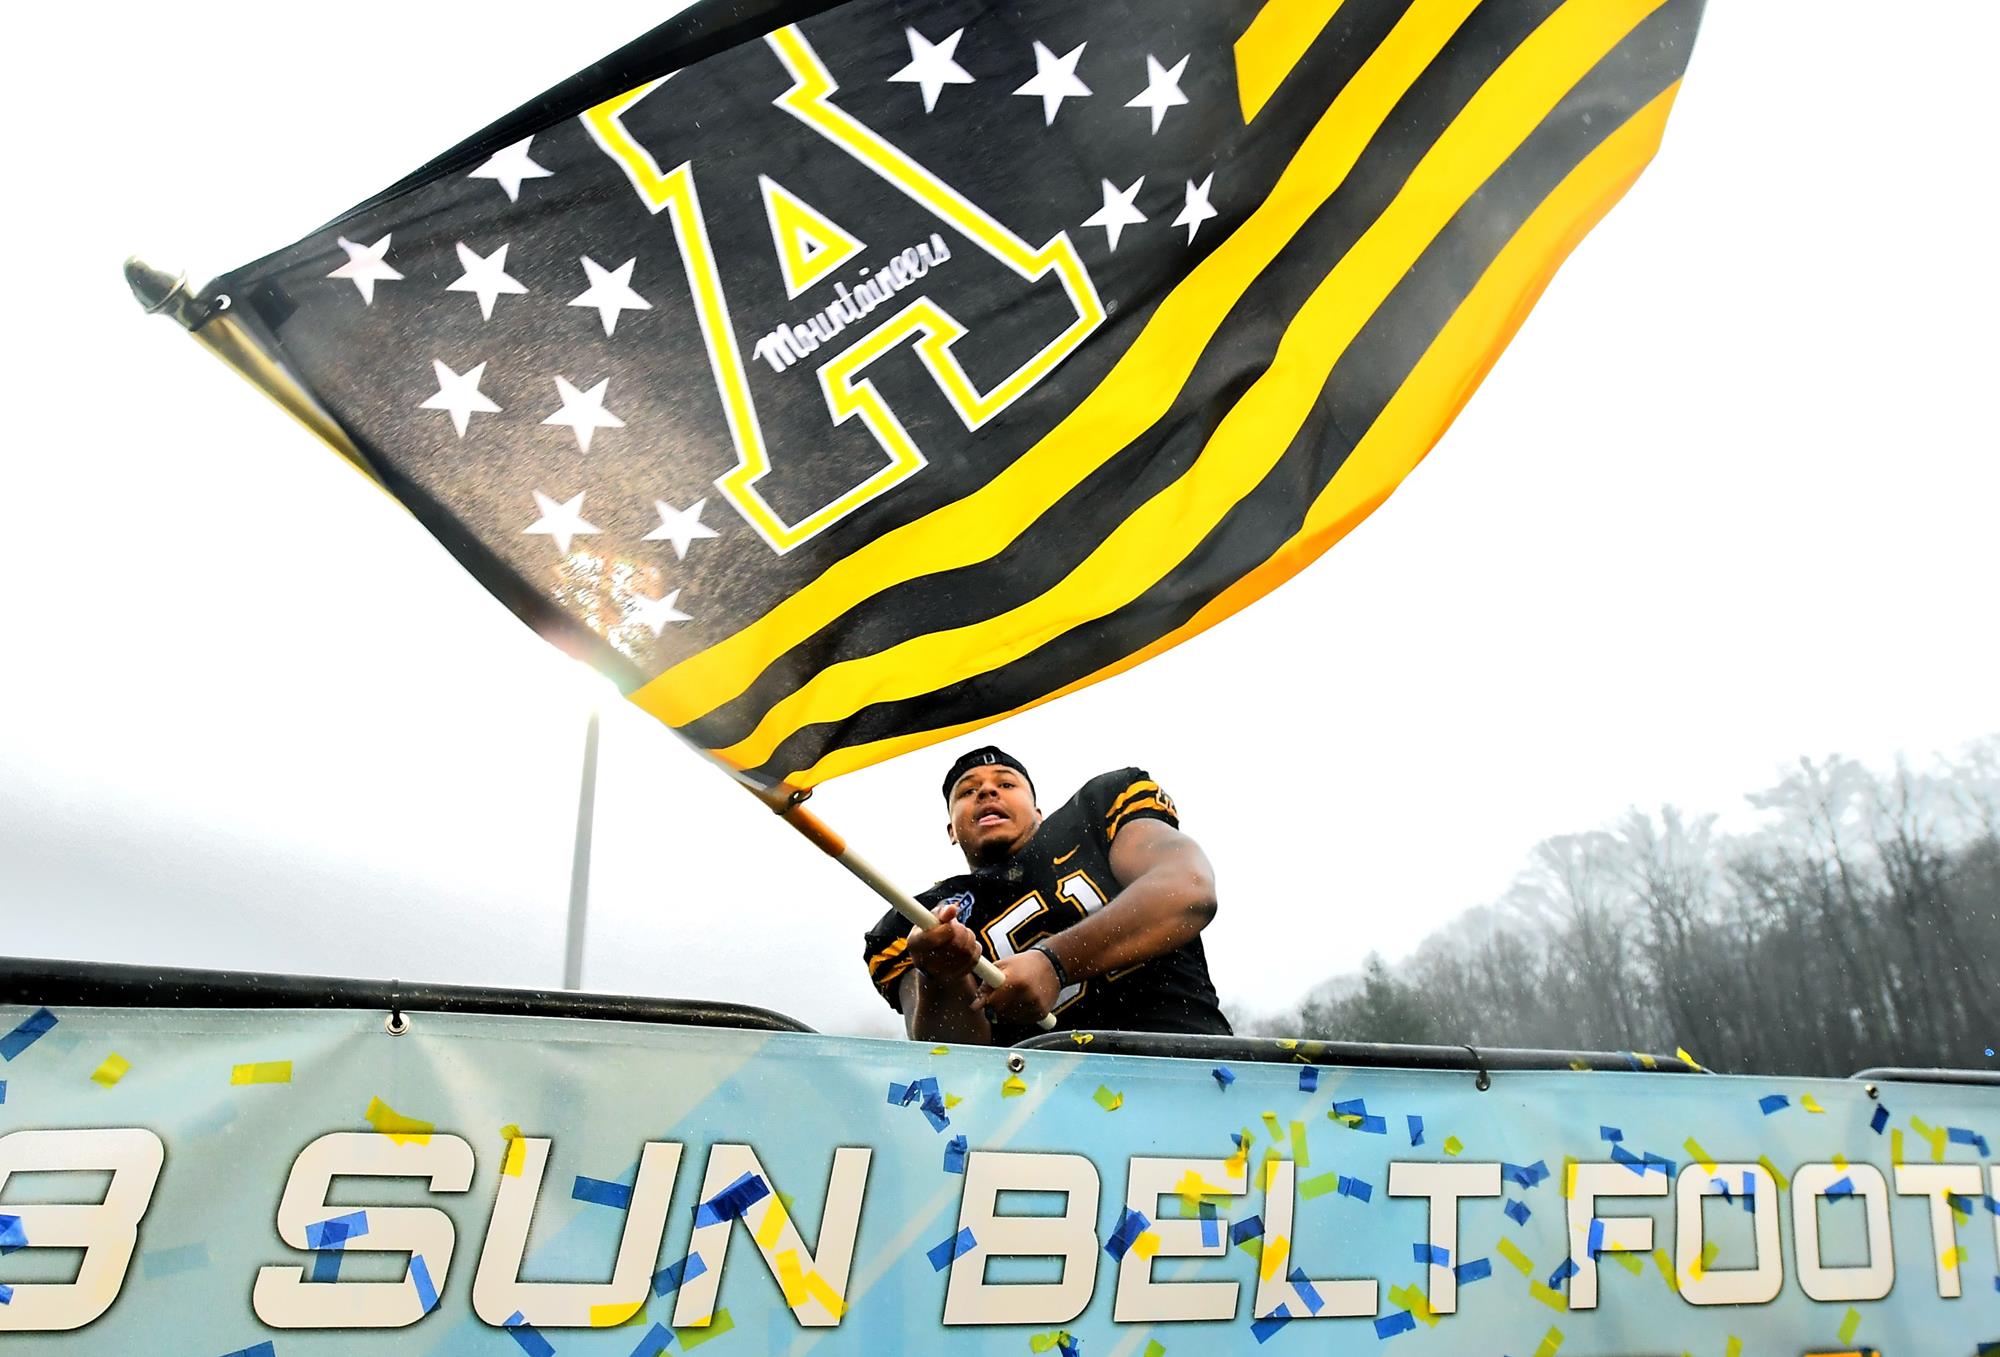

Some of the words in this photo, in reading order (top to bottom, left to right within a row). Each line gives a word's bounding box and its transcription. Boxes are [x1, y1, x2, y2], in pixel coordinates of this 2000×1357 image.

[752, 233, 951, 373] Mountaineers
[253, 1132, 873, 1328] SUN
[943, 1151, 1501, 1325] BELT
[1567, 1162, 2000, 1306] FOOT
